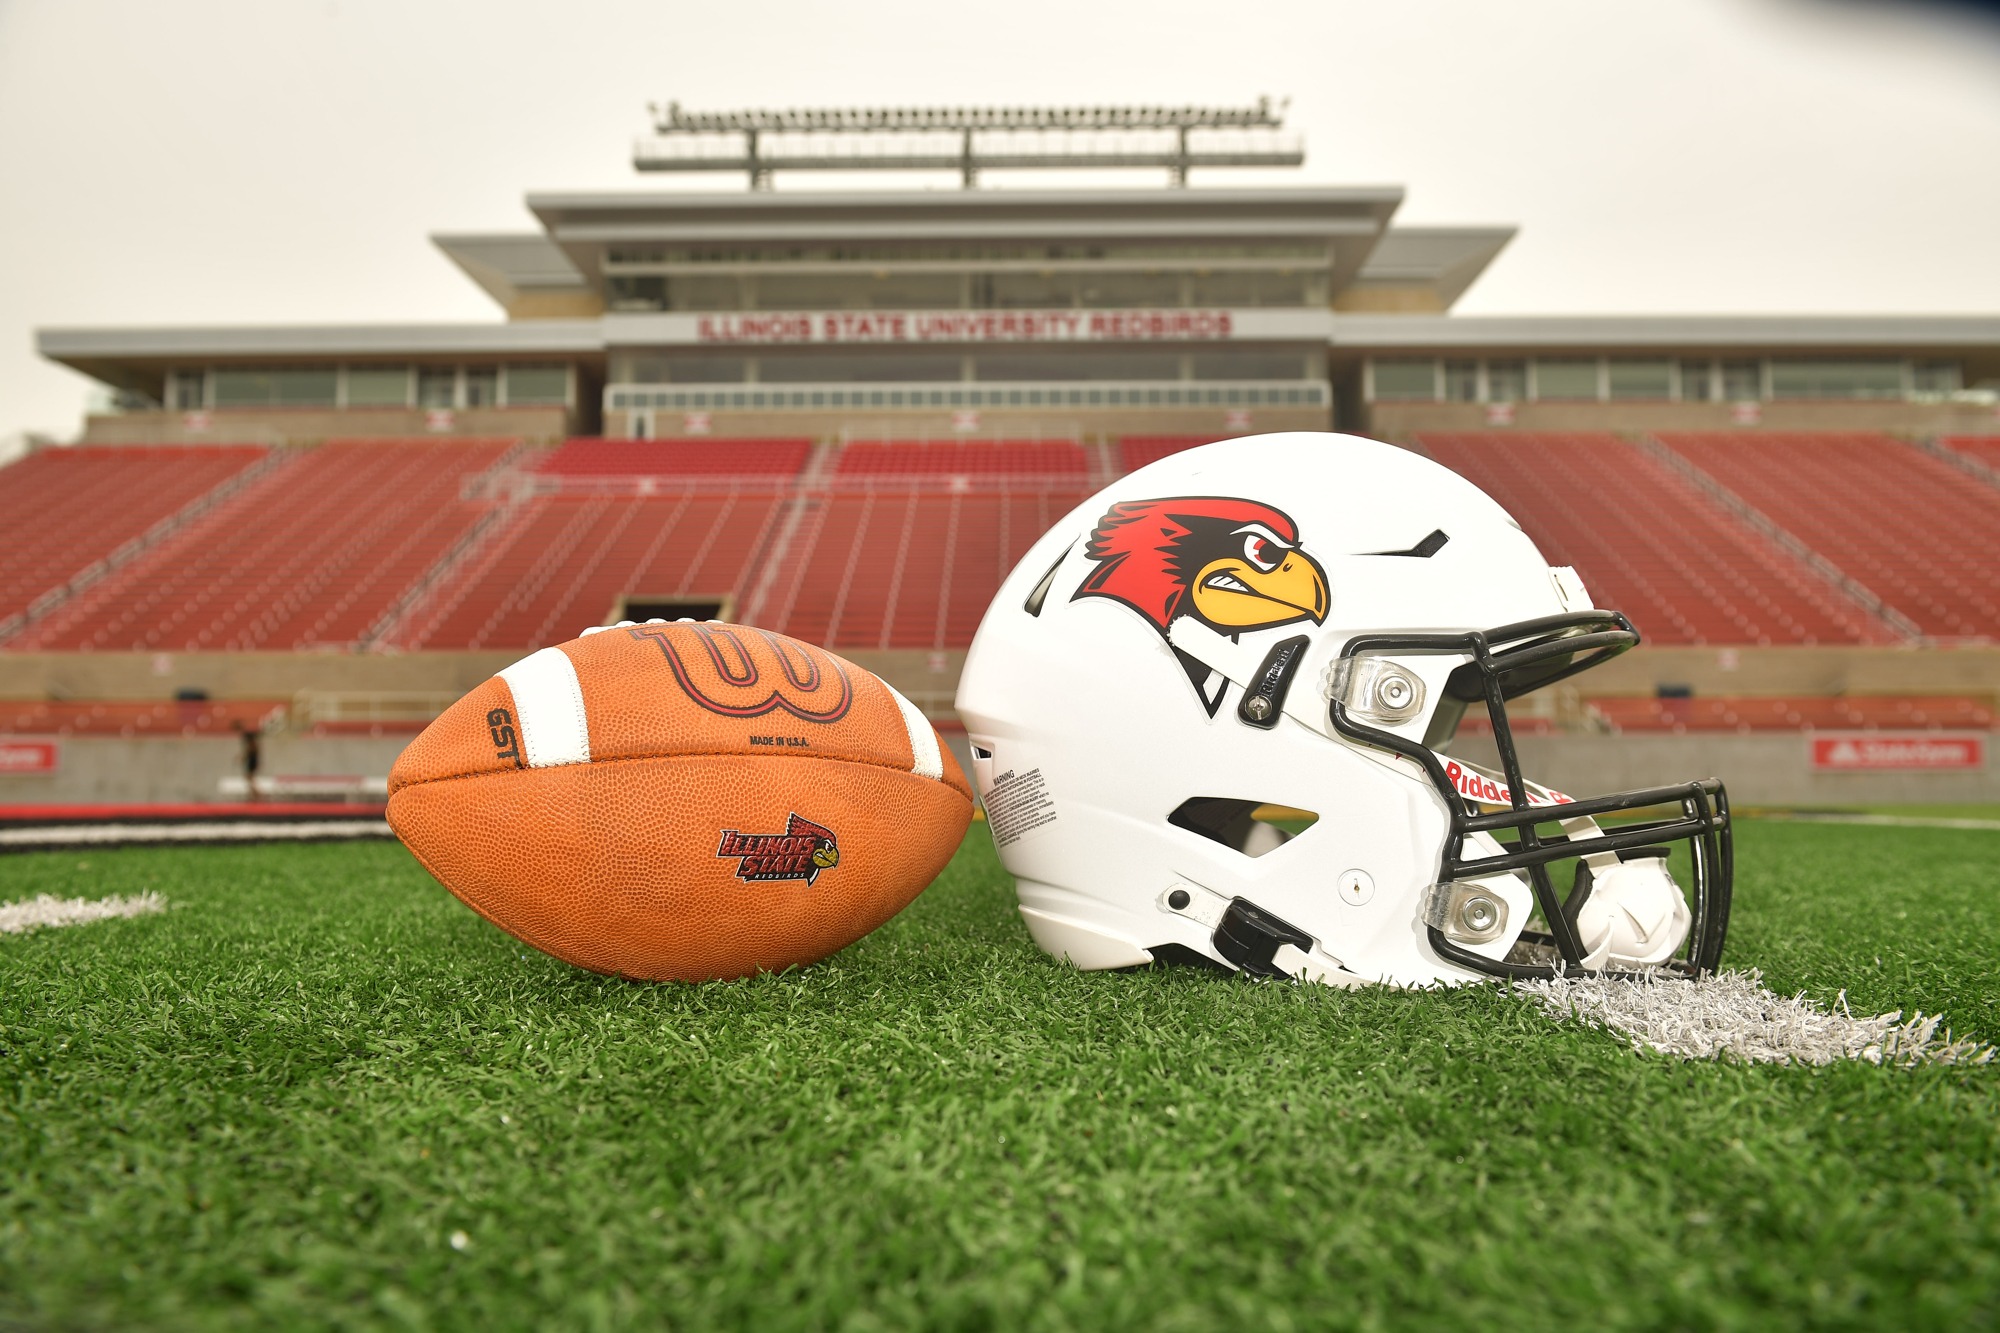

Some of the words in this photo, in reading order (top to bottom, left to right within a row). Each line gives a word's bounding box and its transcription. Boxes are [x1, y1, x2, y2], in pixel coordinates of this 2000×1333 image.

[697, 313, 812, 340] ILLINOIS
[823, 313, 906, 340] STATE
[914, 312, 1081, 340] UNIVERSITY
[1089, 311, 1233, 338] REDBIRDS
[487, 707, 524, 769] GST
[750, 735, 774, 746] MADE
[776, 736, 785, 746] IN
[786, 736, 810, 747] U.S.A.
[993, 769, 1015, 787] WARNING
[1445, 760, 1540, 804] Riddel
[719, 832, 816, 856] ILLINOIS
[740, 855, 809, 876] STATE
